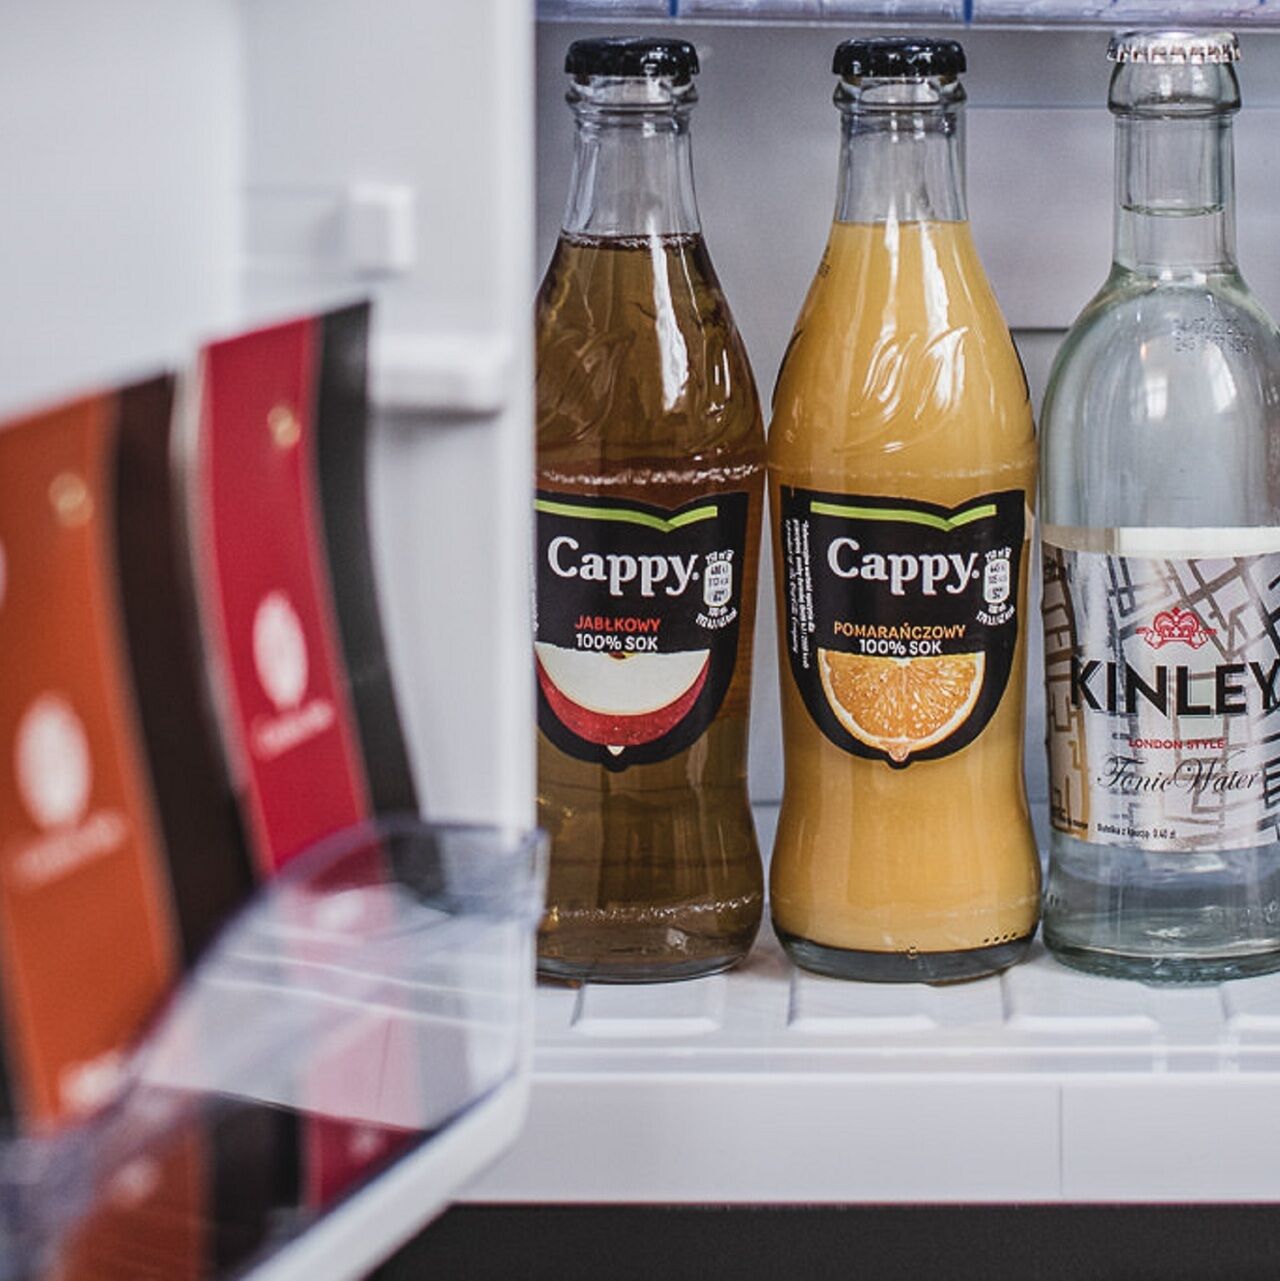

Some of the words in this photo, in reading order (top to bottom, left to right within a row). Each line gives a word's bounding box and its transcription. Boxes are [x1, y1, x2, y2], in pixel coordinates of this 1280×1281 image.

[574, 615, 661, 633] JABŁKOWY
[833, 621, 966, 640] POMARAŃCZOWY
[576, 632, 621, 651] 100%
[624, 635, 659, 651] SOK
[859, 638, 907, 656] 100%
[909, 639, 943, 656] SOK
[1127, 738, 1183, 750] LONDON
[1186, 738, 1226, 750] STYLE
[1096, 754, 1173, 793] Tonic
[1173, 749, 1260, 794] Water
